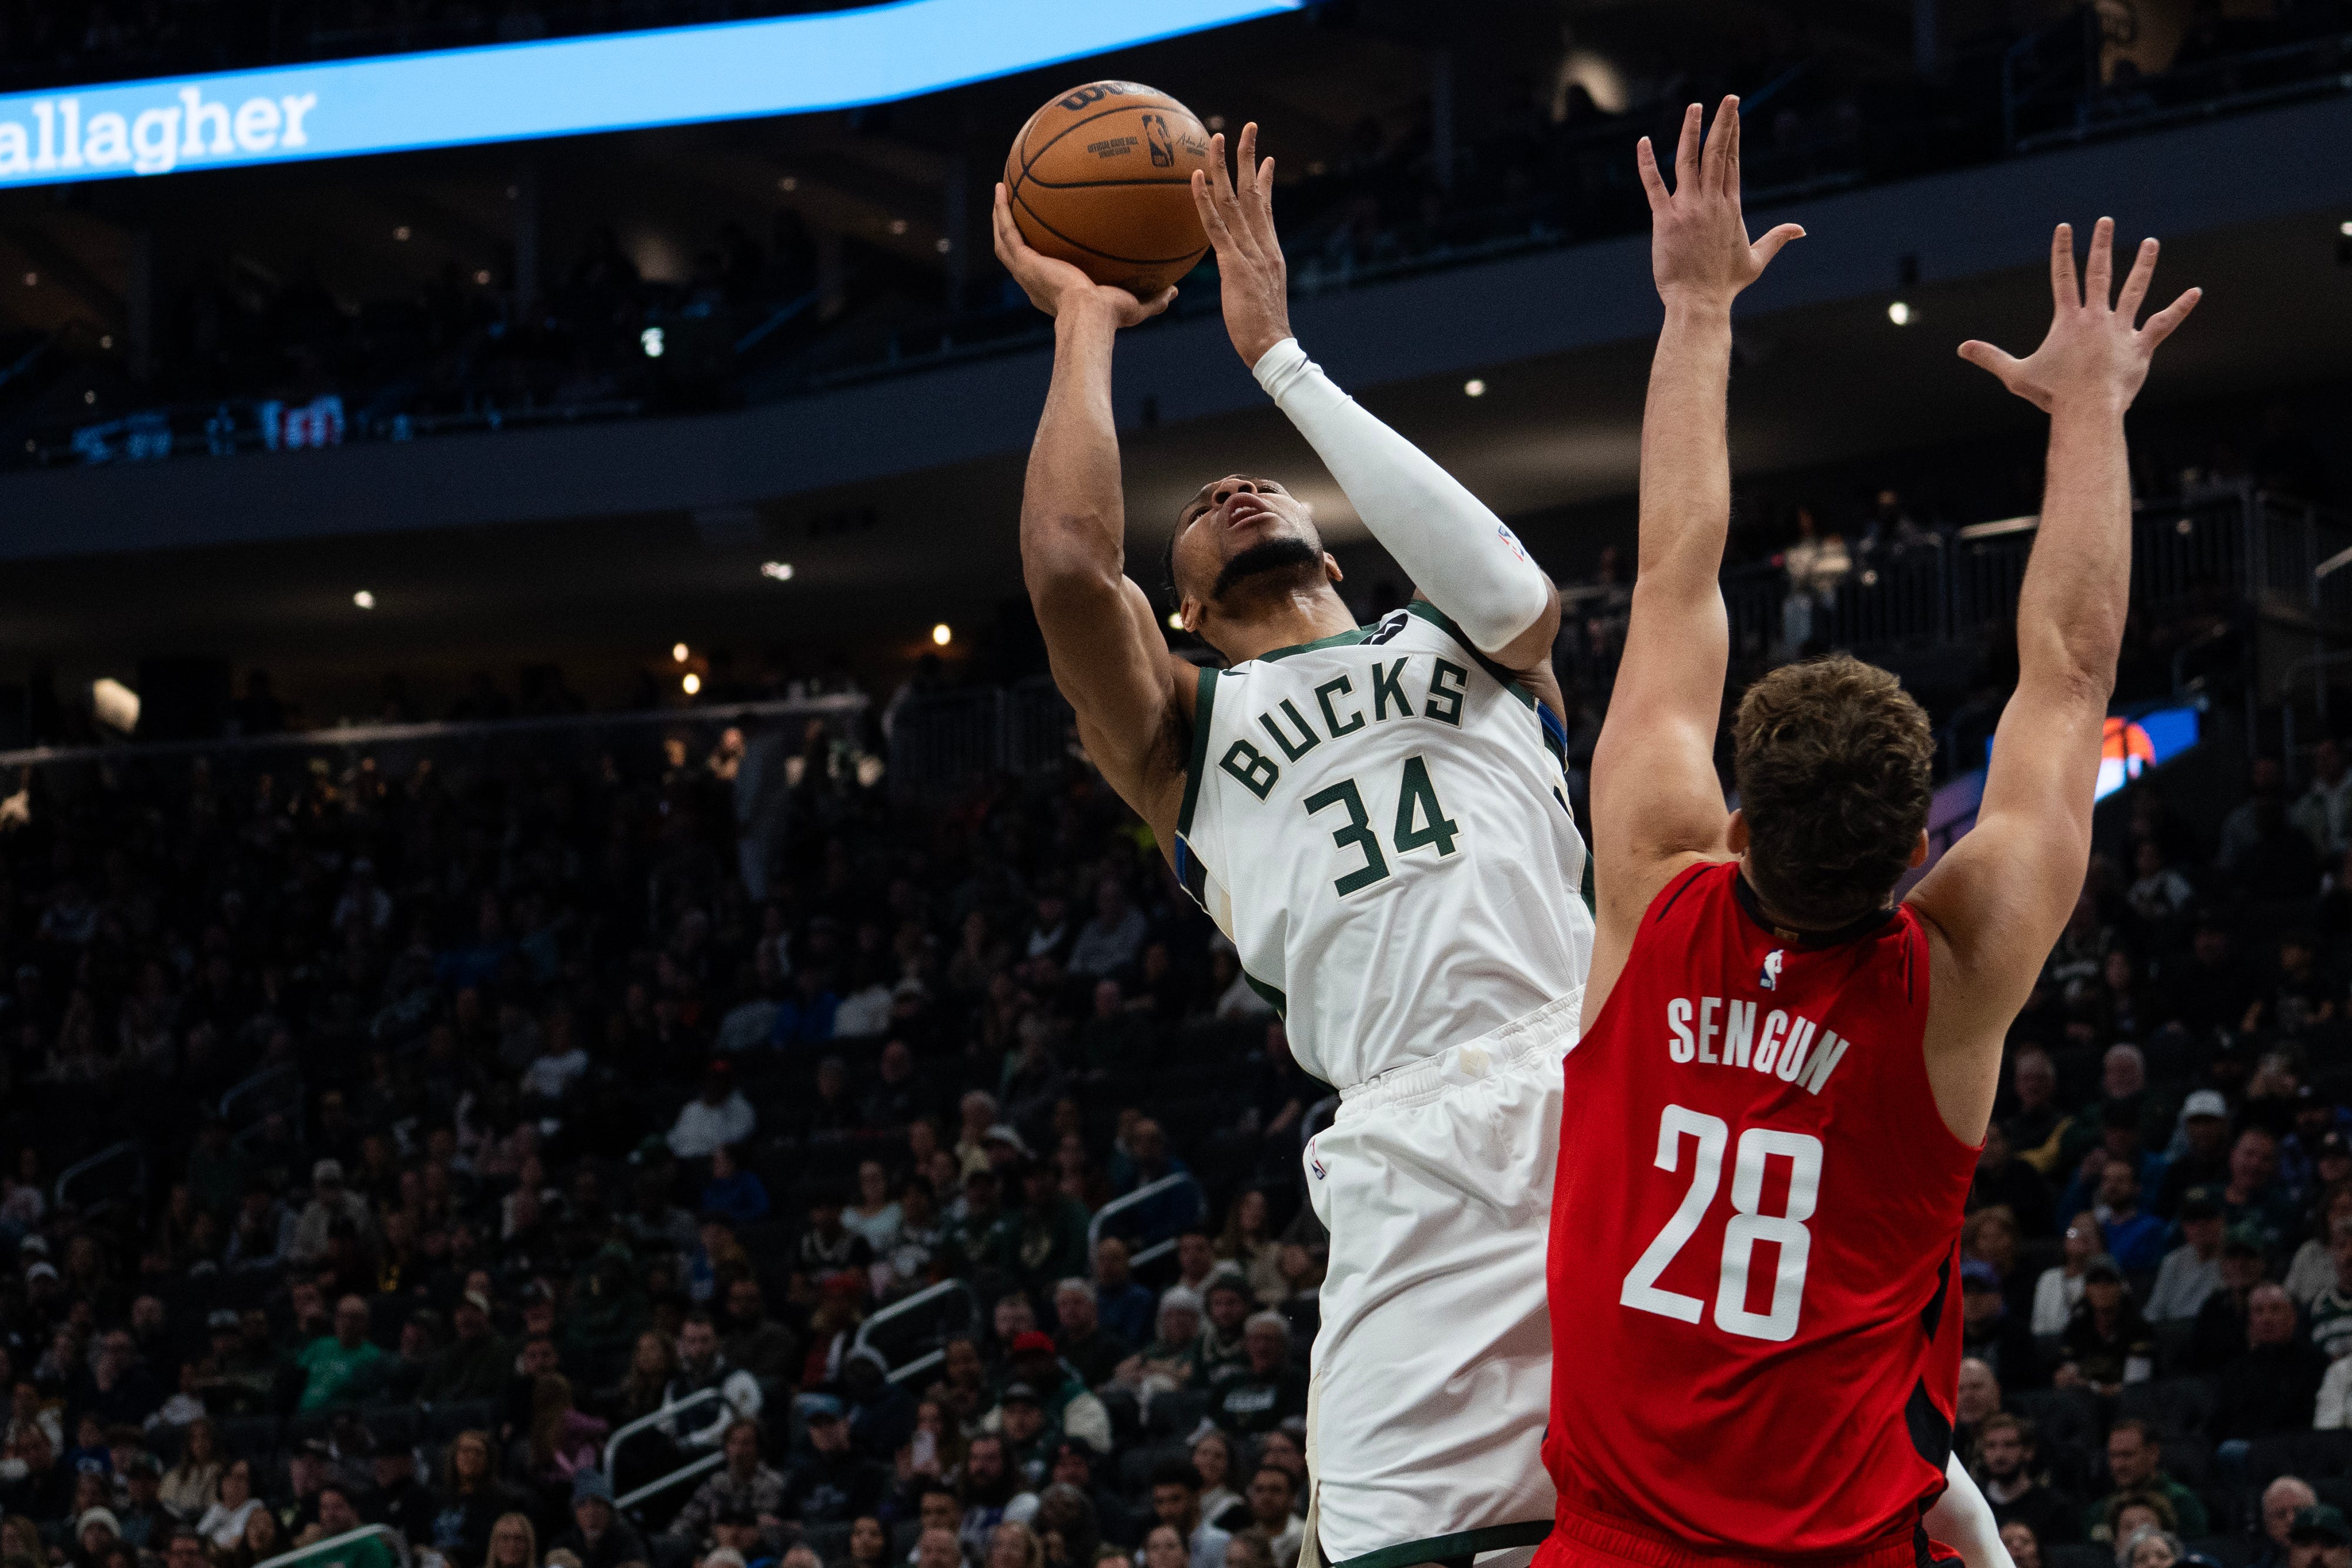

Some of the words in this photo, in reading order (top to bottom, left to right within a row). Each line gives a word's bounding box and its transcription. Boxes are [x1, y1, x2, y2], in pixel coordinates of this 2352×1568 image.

[0, 87, 316, 175] allagher
[1219, 654, 1469, 803] BUCKS
[1300, 752, 1463, 901] 34
[1667, 997, 1850, 1095] SENGUN
[1619, 1104, 1823, 1342] 28
